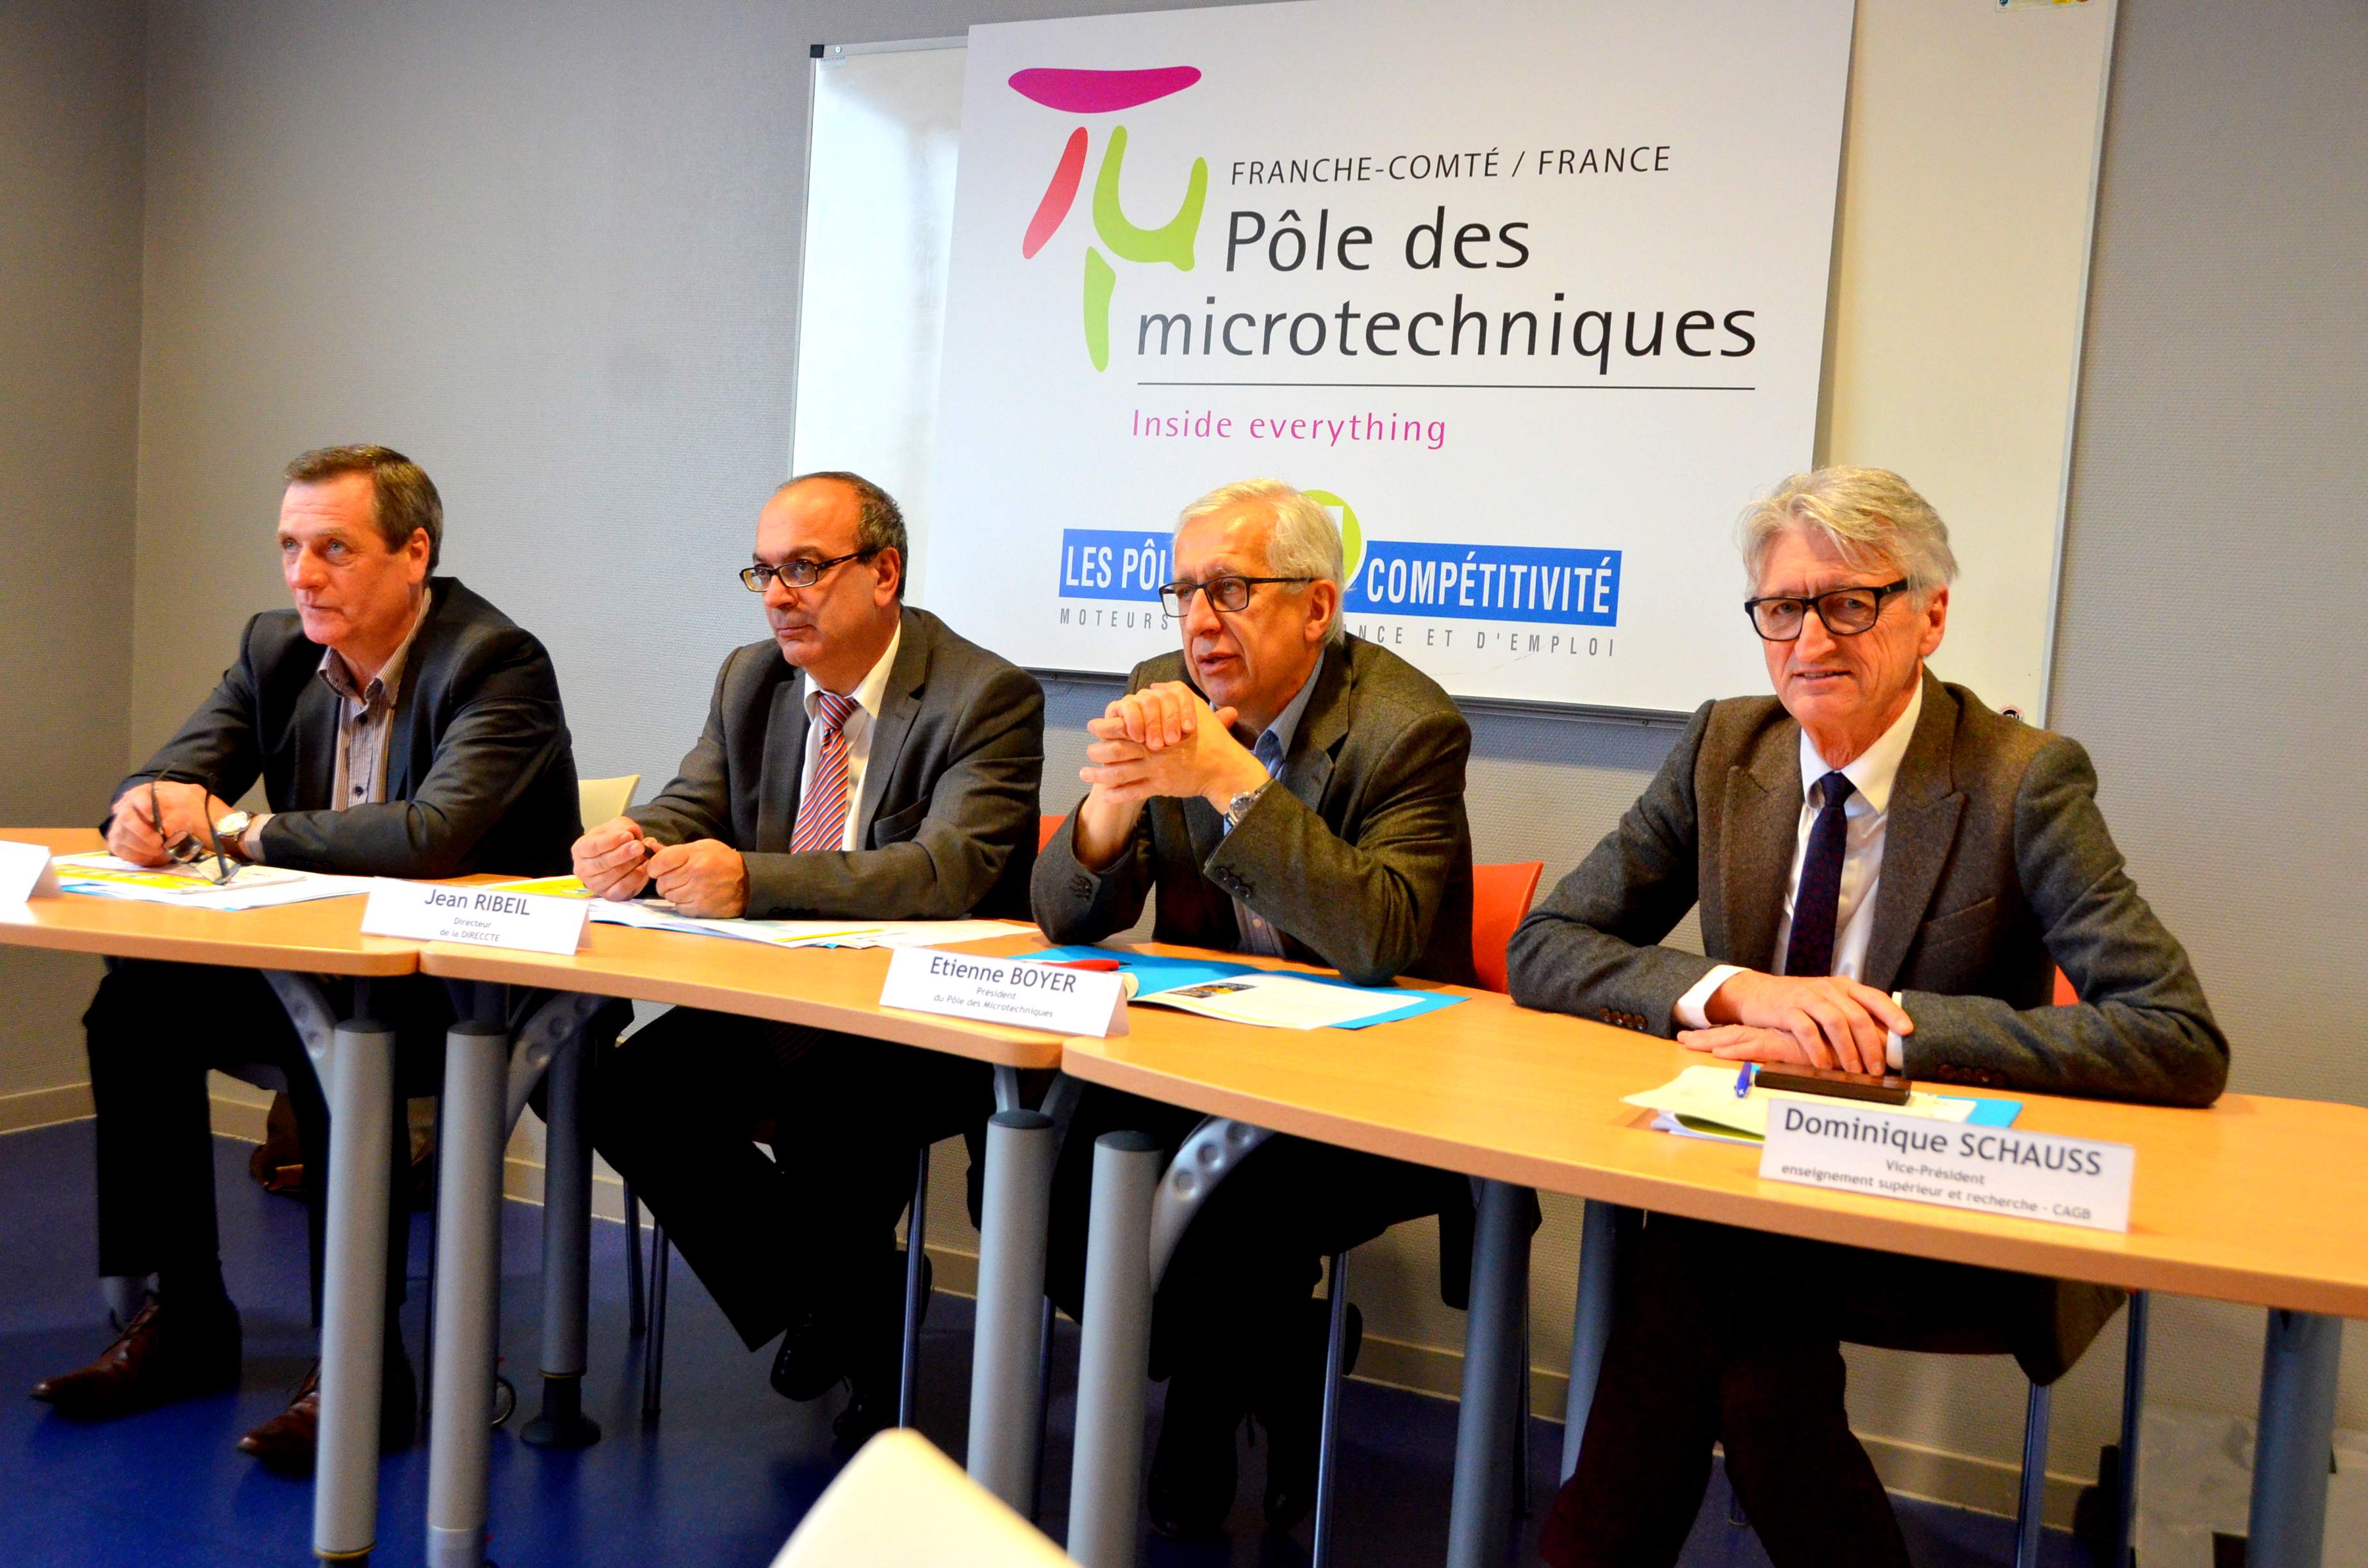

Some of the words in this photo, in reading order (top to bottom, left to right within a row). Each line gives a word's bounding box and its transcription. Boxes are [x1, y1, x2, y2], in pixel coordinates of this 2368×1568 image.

[1231, 147, 1500, 186] FRANCHE-COMTÉ
[1538, 145, 1672, 176] FRANCE
[1226, 209, 1373, 272] Pôle
[1405, 206, 1530, 269] des
[1137, 293, 1756, 375] microtechniques
[1133, 409, 1232, 438] Inside
[1250, 412, 1446, 450] everything
[1066, 546, 1112, 588] LES
[1121, 539, 1167, 590] PÔL
[1367, 551, 1612, 614] COMPÉTITIVITÉ
[1060, 608, 1168, 630] MOTEURS
[1427, 629, 1452, 646] ET
[1477, 632, 1613, 656] D'EMPLOI
[424, 889, 468, 908] Jean
[474, 894, 530, 915] RIBEIL
[454, 917, 492, 929] Directeur
[461, 931, 500, 942] DIRECCTE
[930, 956, 1003, 983] Etienne
[1010, 967, 1076, 993] BOYER
[976, 987, 1016, 1000] Président
[933, 994, 944, 1003] du
[947, 995, 964, 1006] Pôle
[967, 999, 981, 1008] des
[983, 1001, 1053, 1018] Microtechniques
[1786, 1108, 1948, 1153] Dominique
[1960, 1133, 2101, 1175] SCHAUSS
[1781, 1164, 1873, 1188] enseignement
[1879, 1176, 1943, 1197] supérieur
[1948, 1189, 1961, 1200] et
[1967, 1191, 2038, 1212] recherche
[2052, 1204, 2091, 1220] CAGB
[1886, 1159, 1985, 1186] Vice-Président
